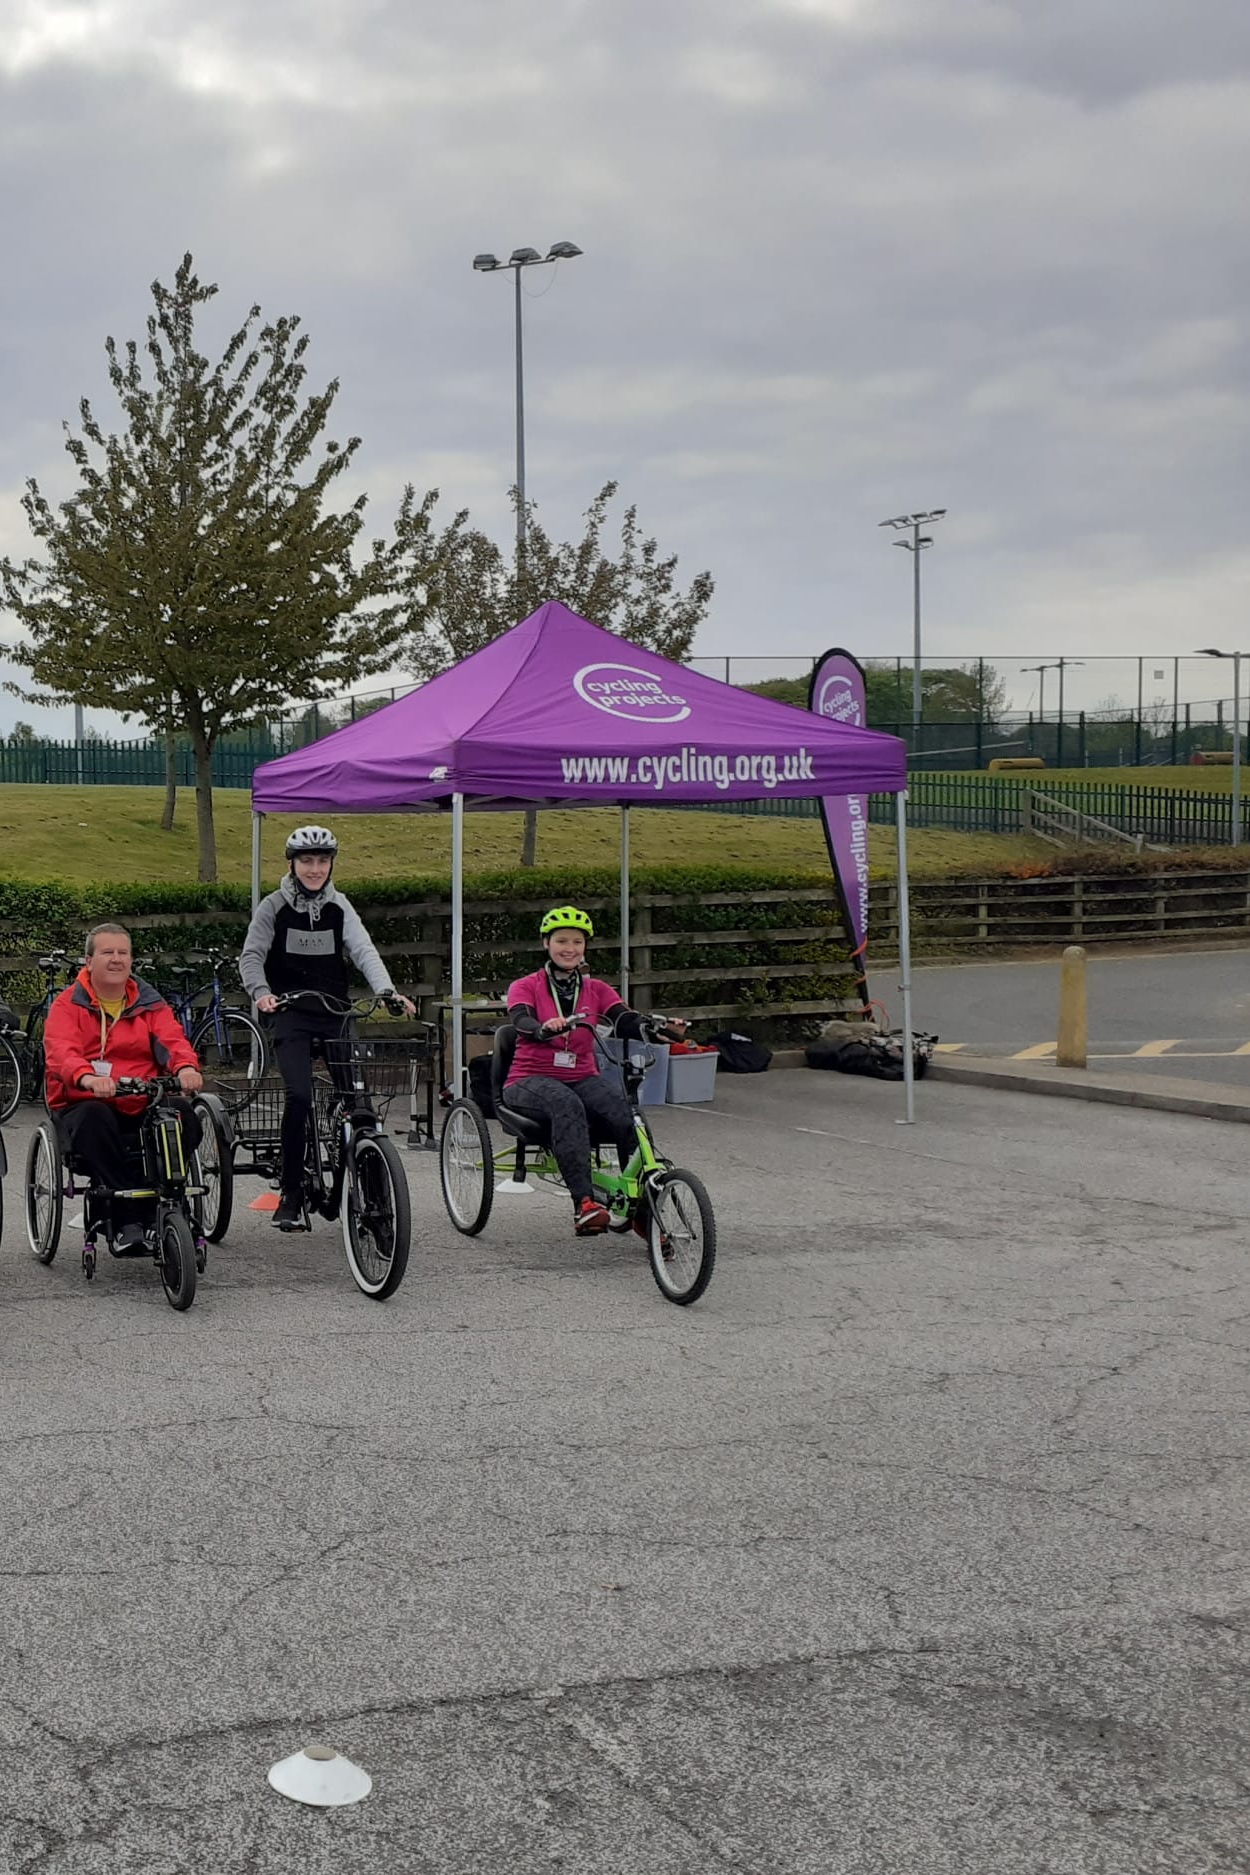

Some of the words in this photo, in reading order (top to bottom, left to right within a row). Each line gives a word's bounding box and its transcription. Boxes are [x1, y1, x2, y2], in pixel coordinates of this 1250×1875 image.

[587, 679, 662, 694] cycling
[598, 692, 686, 707] projects
[824, 690, 852, 713] cycling
[831, 700, 860, 722] ojects
[560, 747, 816, 790] www.cycling.org.uk
[847, 793, 869, 934] www.cycling.or
